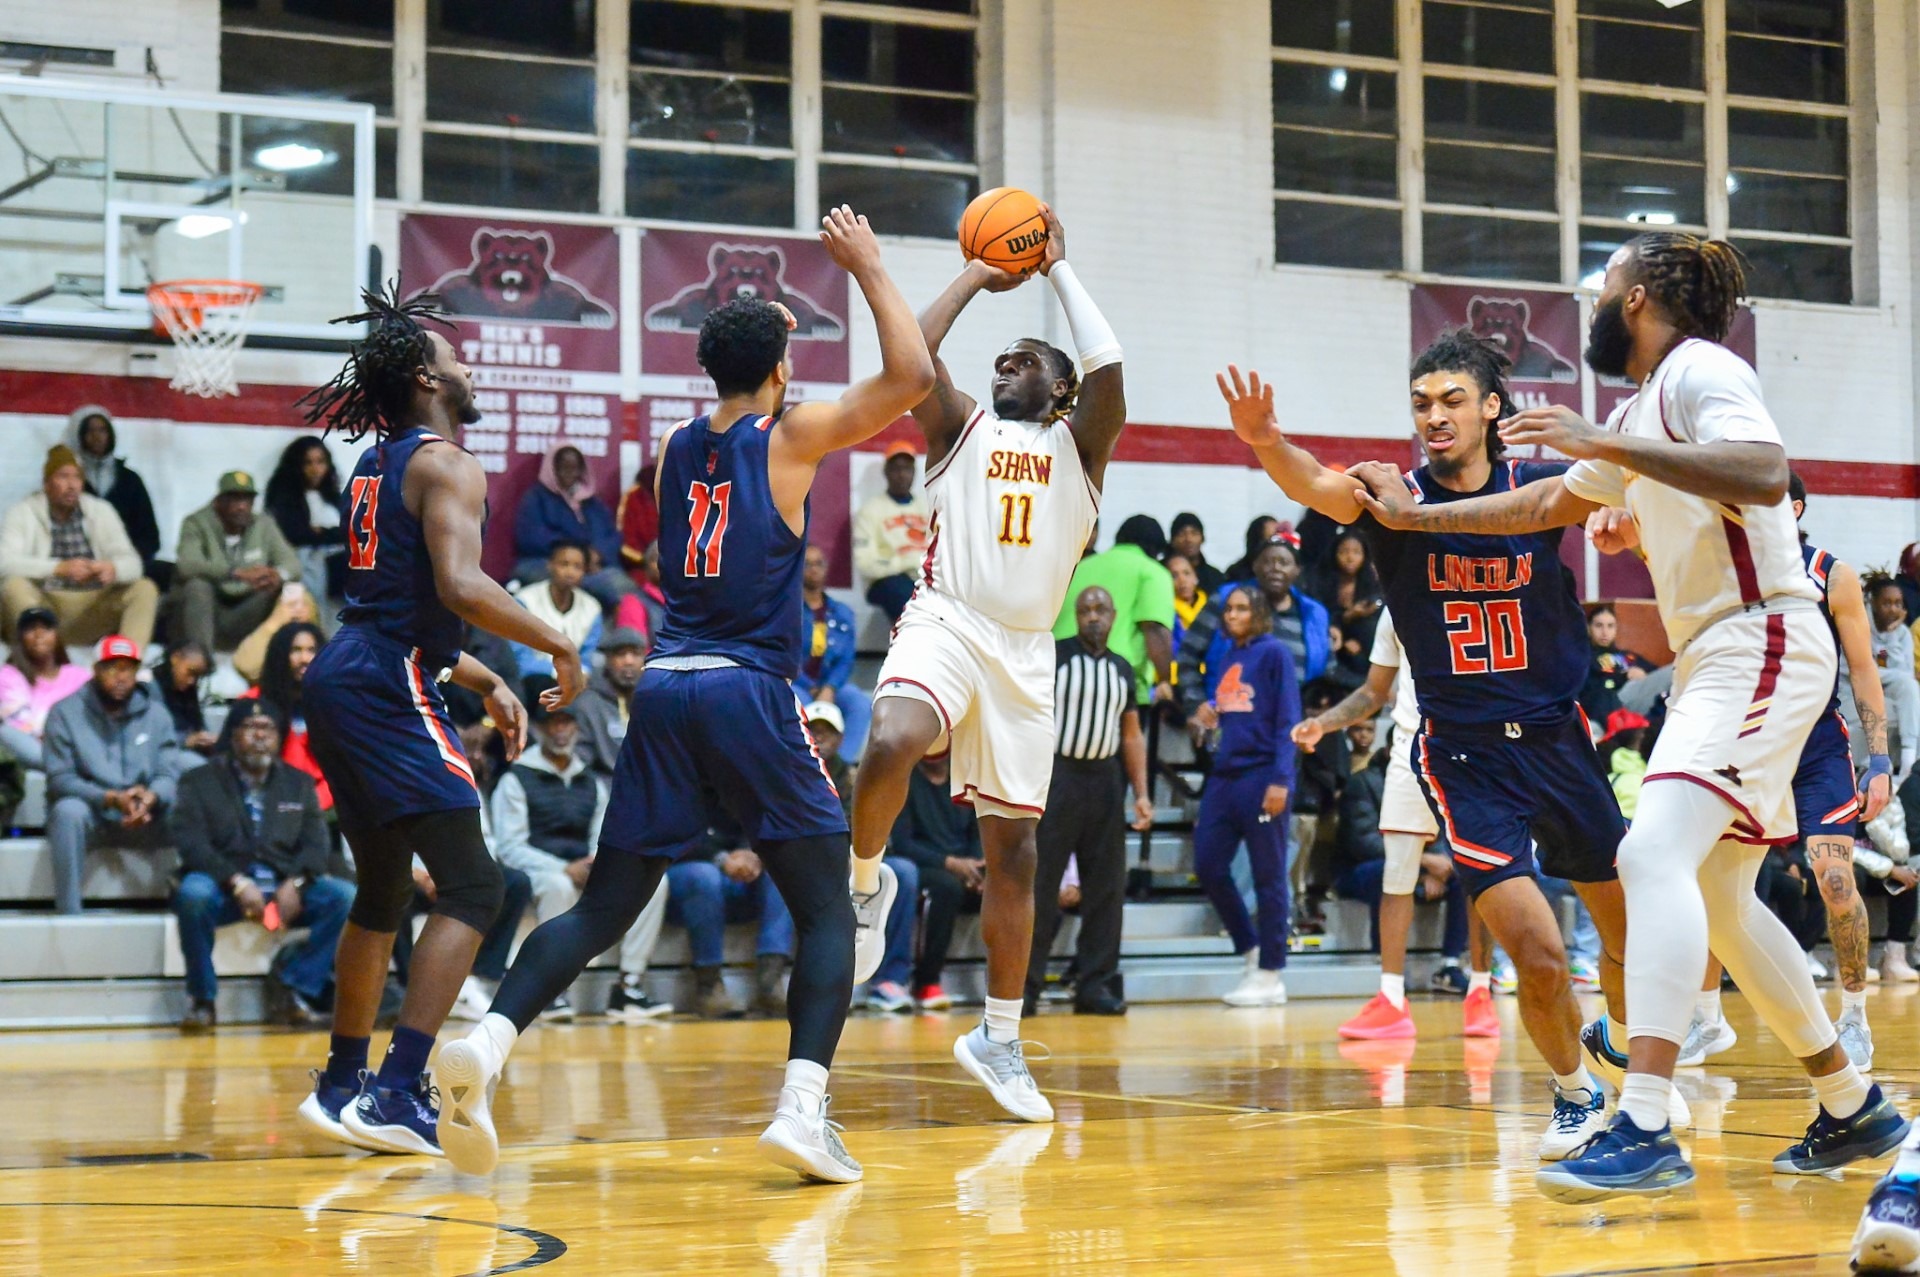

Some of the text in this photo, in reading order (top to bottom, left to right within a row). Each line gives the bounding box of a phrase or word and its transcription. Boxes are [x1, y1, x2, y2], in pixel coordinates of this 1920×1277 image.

[1006, 228, 1049, 255] Wils
[461, 340, 561, 367] TENNIS
[480, 324, 544, 344] MEN'S
[987, 450, 1053, 486] SHAW
[348, 474, 383, 570] 13
[684, 480, 732, 577] 11
[997, 491, 1034, 547] 11
[1428, 552, 1533, 592] LINCOLN
[1443, 598, 1528, 675] 20
